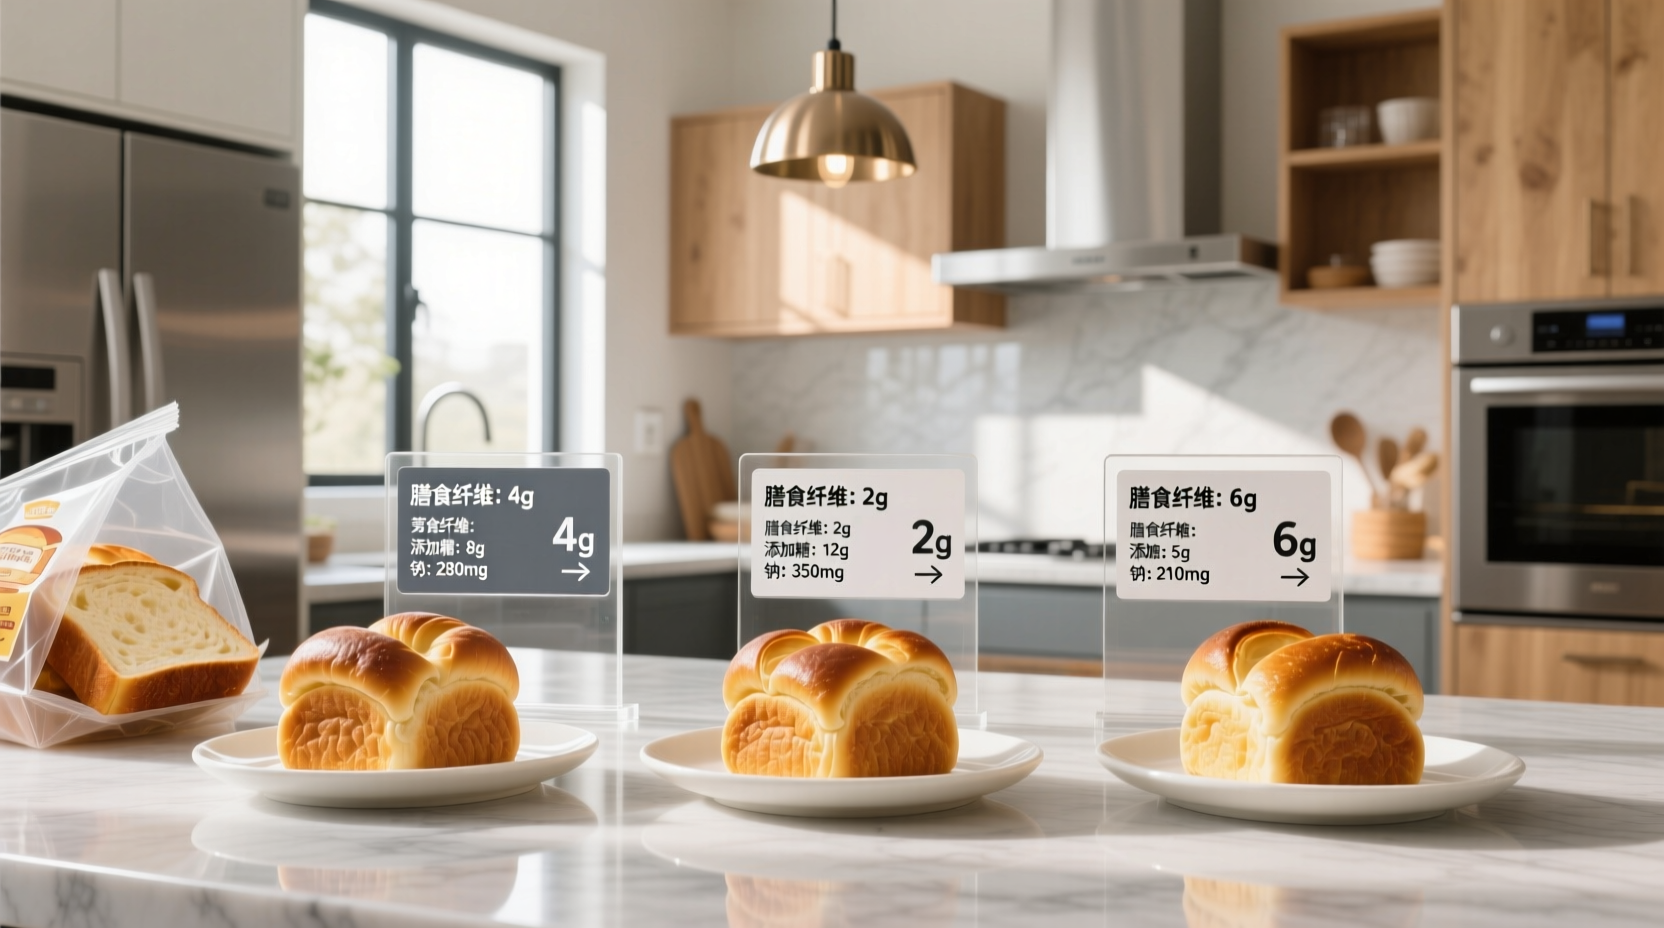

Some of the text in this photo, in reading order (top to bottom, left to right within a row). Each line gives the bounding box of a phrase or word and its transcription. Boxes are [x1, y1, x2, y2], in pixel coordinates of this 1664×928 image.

[508, 485, 534, 510] 4g
[862, 487, 888, 511] 2g
[1229, 488, 1257, 513] 6g
[552, 516, 595, 558] 4g
[833, 521, 851, 538] 2g
[466, 540, 485, 558] 8g
[912, 519, 952, 560] 2g
[1273, 521, 1317, 563] 6g
[823, 542, 849, 560] 12g
[1172, 545, 1190, 563] 5g
[435, 561, 488, 580] 280mg
[791, 563, 844, 582] 350mg
[1156, 566, 1210, 585] 210mg
